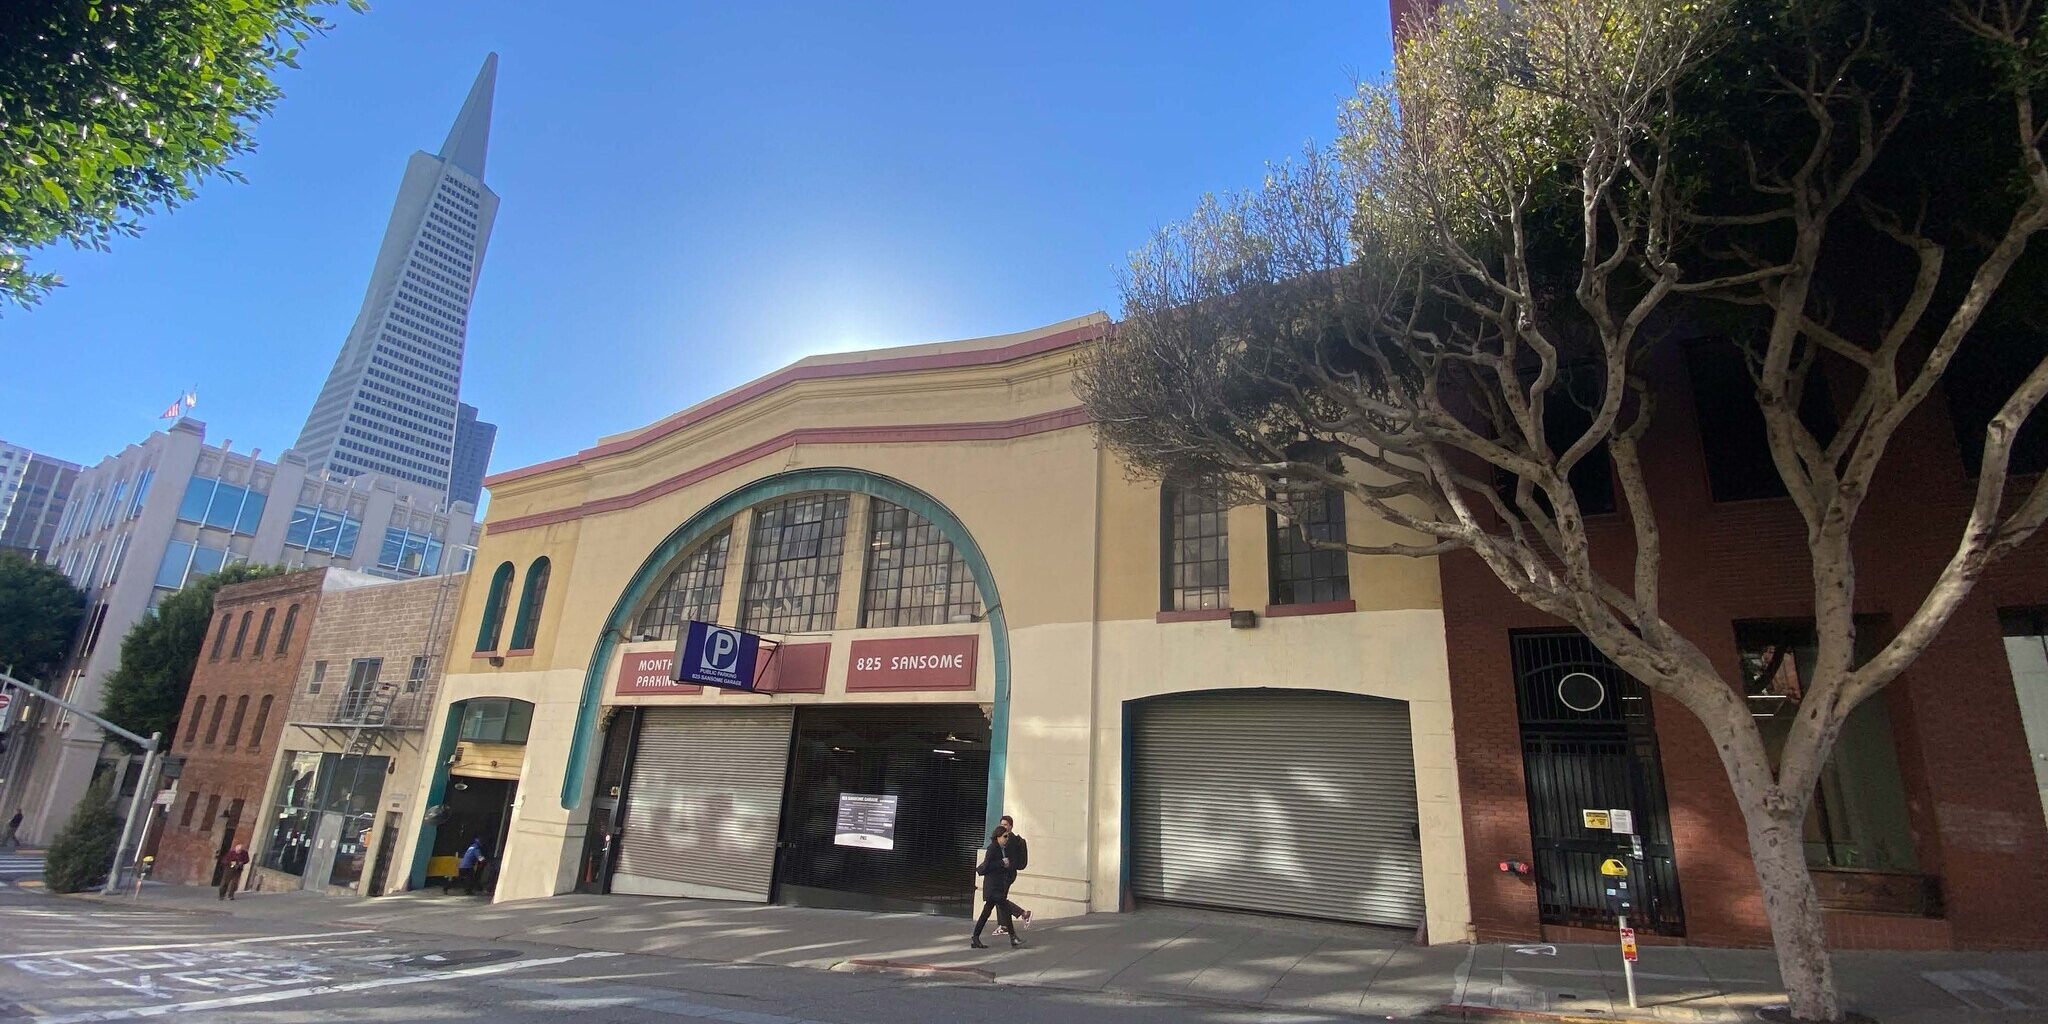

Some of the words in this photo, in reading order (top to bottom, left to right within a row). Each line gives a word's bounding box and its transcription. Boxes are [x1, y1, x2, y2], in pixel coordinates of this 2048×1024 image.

[712, 632, 734, 666] P
[638, 659, 673, 671] MONTH
[856, 657, 882, 671] 825
[890, 654, 963, 670] SANSOME
[700, 668, 717, 676] PUBLIC
[717, 671, 738, 679] PARKING
[700, 674, 724, 683] SANSOME
